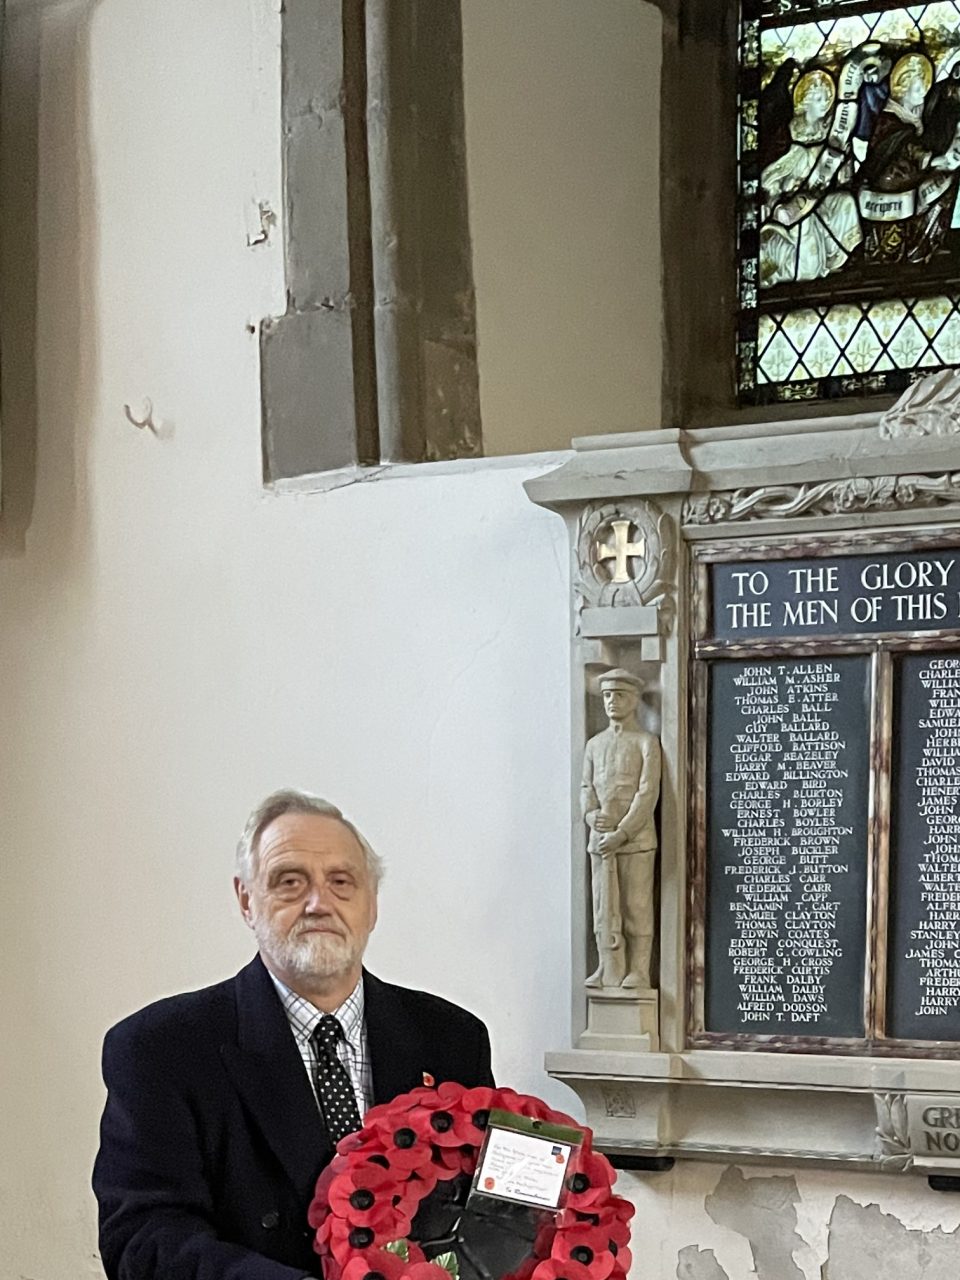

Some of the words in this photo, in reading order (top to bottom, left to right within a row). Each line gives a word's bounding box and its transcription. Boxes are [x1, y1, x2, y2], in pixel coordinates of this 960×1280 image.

[732, 571, 769, 596] TO
[789, 567, 839, 593] THE
[861, 560, 955, 590] GLORY
[726, 602, 771, 628] THE
[783, 600, 838, 626] MEN
[851, 597, 882, 623] OF
[891, 593, 947, 620] THIS
[747, 686, 778, 696] JOHN
[787, 684, 828, 693] ATKINS
[741, 705, 789, 714] CHARLES
[802, 703, 832, 712] BALL
[746, 724, 768, 733] GUY
[781, 722, 829, 732] BALLARD
[737, 734, 779, 743] WALTER
[790, 732, 839, 741] BALLARD
[730, 743, 782, 753] CLIFFORD
[793, 741, 846, 751] BATTISON
[735, 753, 772, 762] EDGAR
[783, 751, 839, 761] BEAZELEY
[726, 772, 769, 781] EDWARD
[783, 770, 848, 780] BILLINGTON
[732, 791, 780, 799] CHARLES
[737, 809, 780, 818] ERNEST
[793, 808, 835, 817] BOWLER
[736, 912, 778, 920] SAMUEL
[785, 911, 836, 920] CLAYTON
[919, 921, 956, 930] HARRY
[741, 930, 778, 938] EDWIN
[788, 930, 829, 938] COATES
[731, 939, 768, 948] EDWIN
[778, 939, 839, 948] CONQUEST
[745, 975, 778, 983] FRANK
[787, 975, 822, 984] DALBY
[739, 985, 782, 993] WILLIAM
[792, 985, 825, 993] DALBY
[737, 1002, 774, 1011] ALFRED
[783, 1003, 827, 1012] DODSON
[924, 1131, 959, 1151] NO
